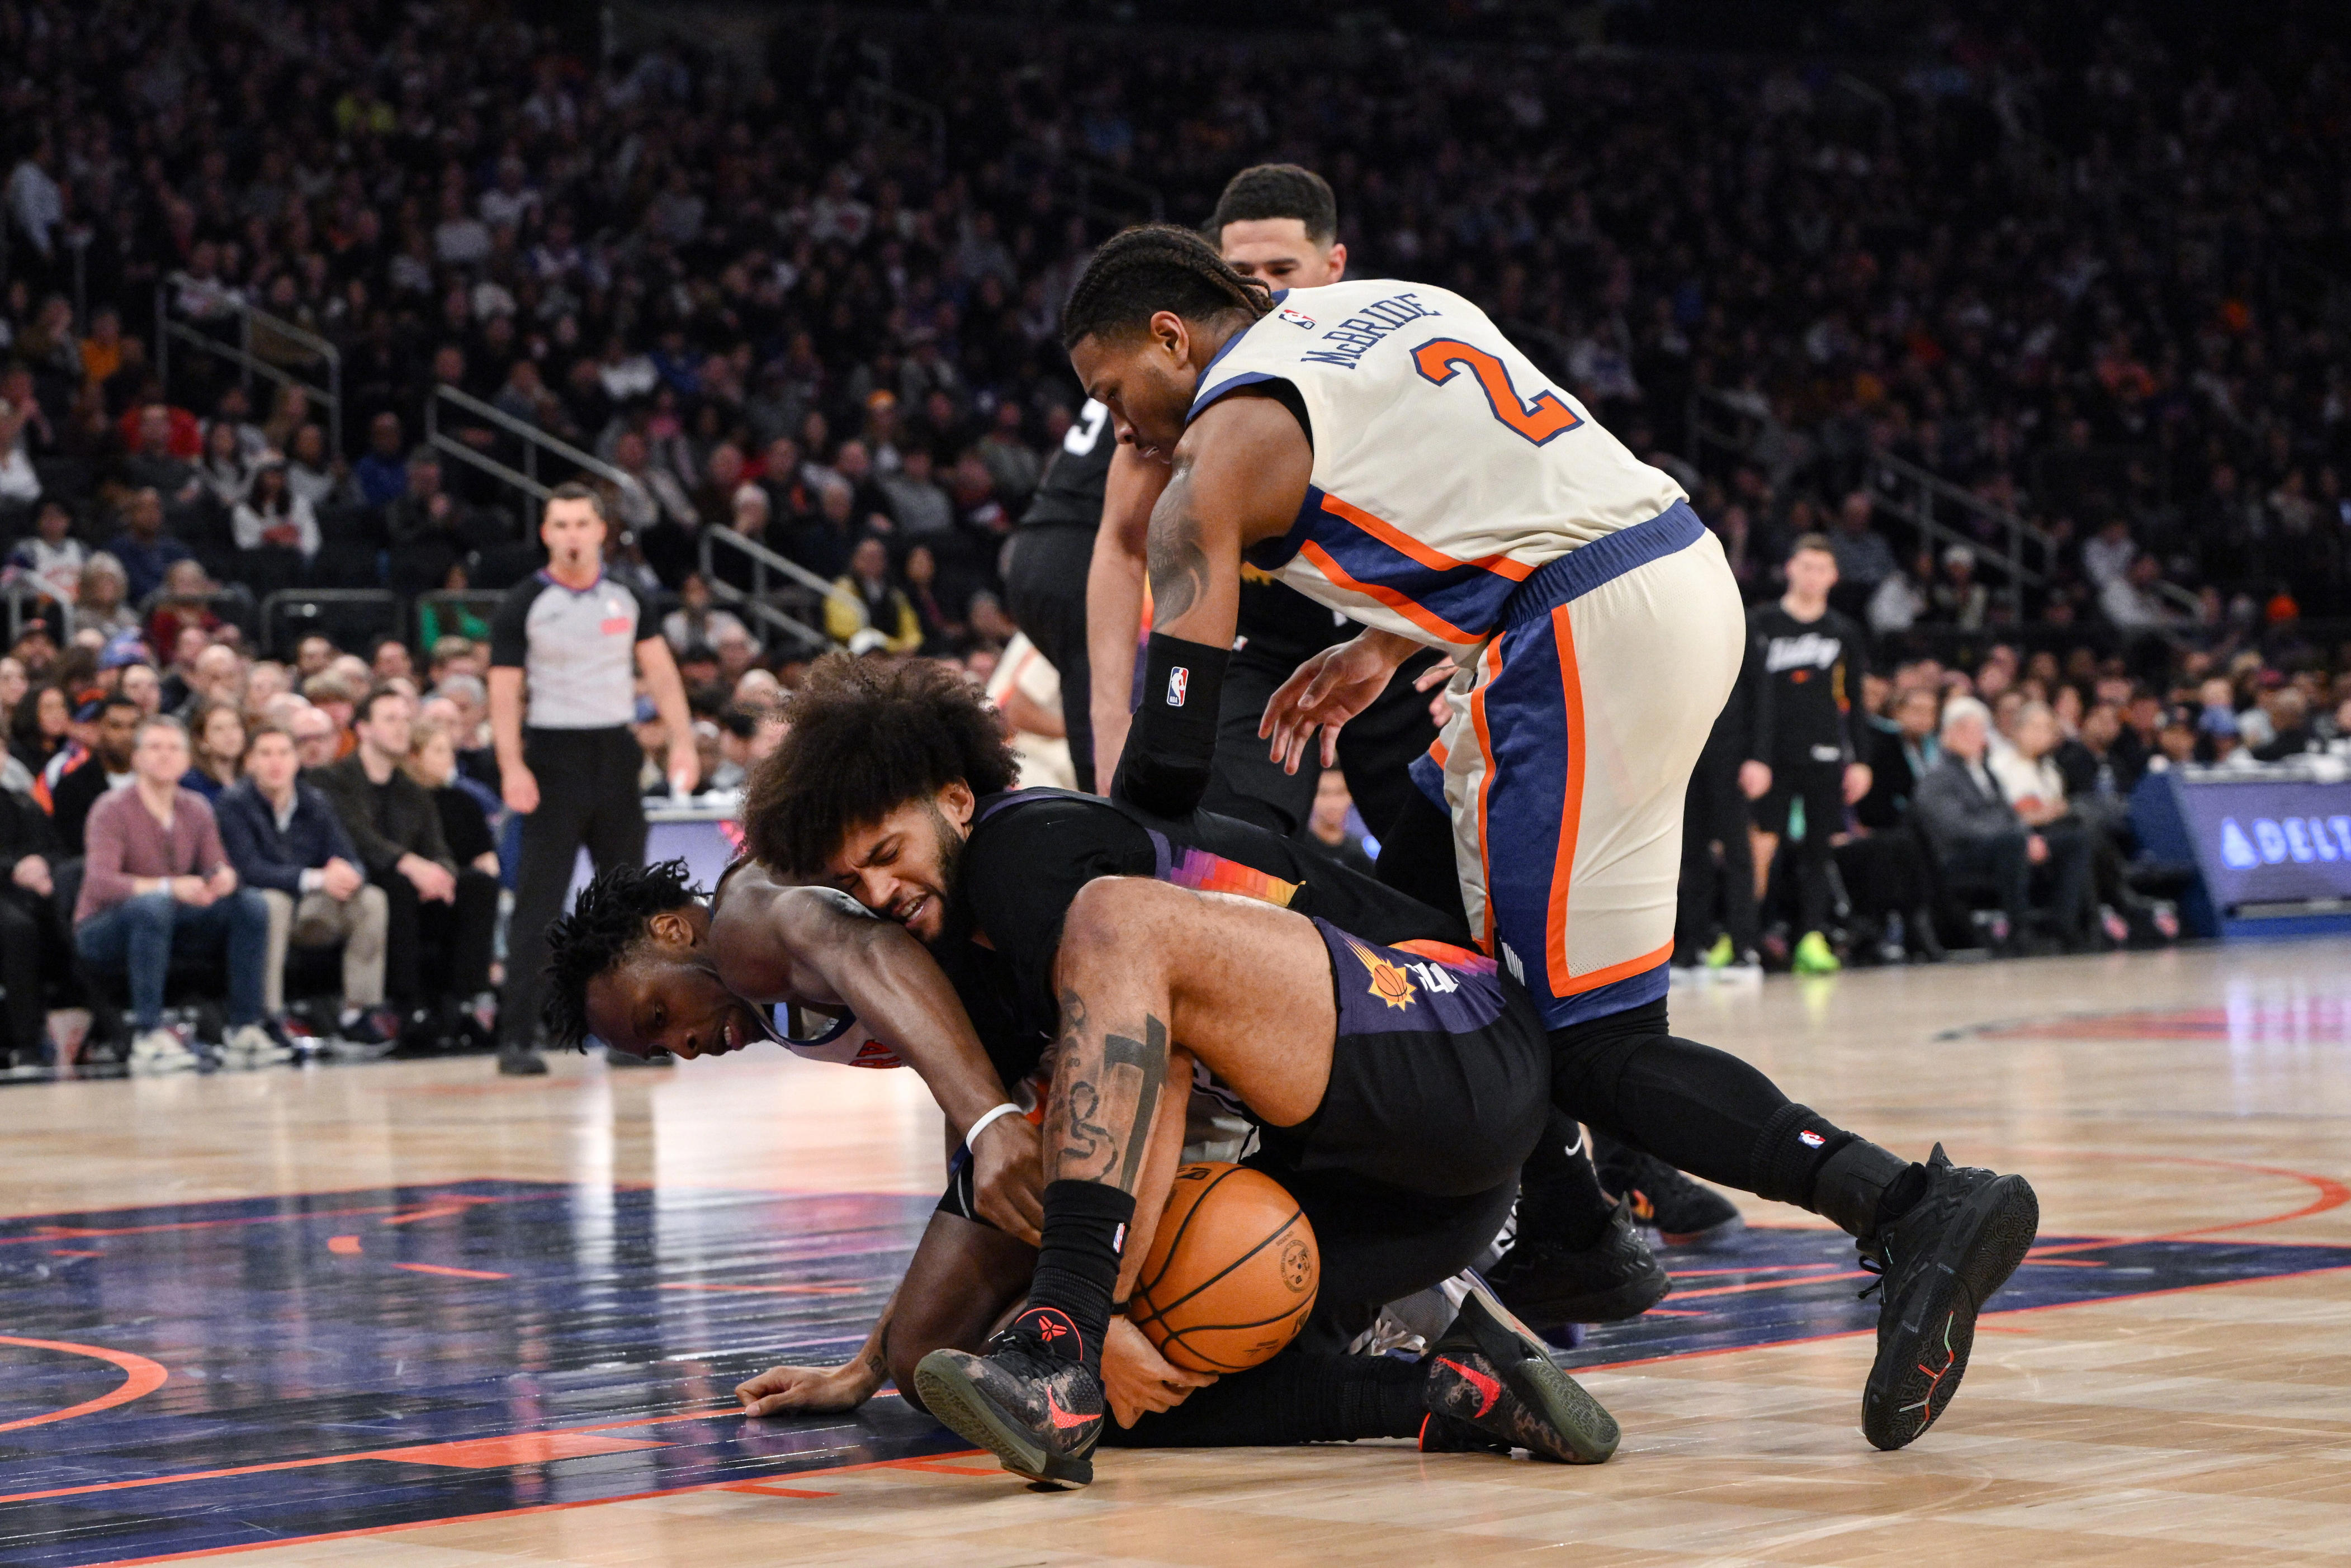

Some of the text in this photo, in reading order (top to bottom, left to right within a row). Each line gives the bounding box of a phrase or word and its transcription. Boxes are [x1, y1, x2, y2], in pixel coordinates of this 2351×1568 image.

[1300, 293, 1442, 370] McBRIDE
[1064, 397, 1109, 456] 3
[1409, 337, 1585, 448] 2
